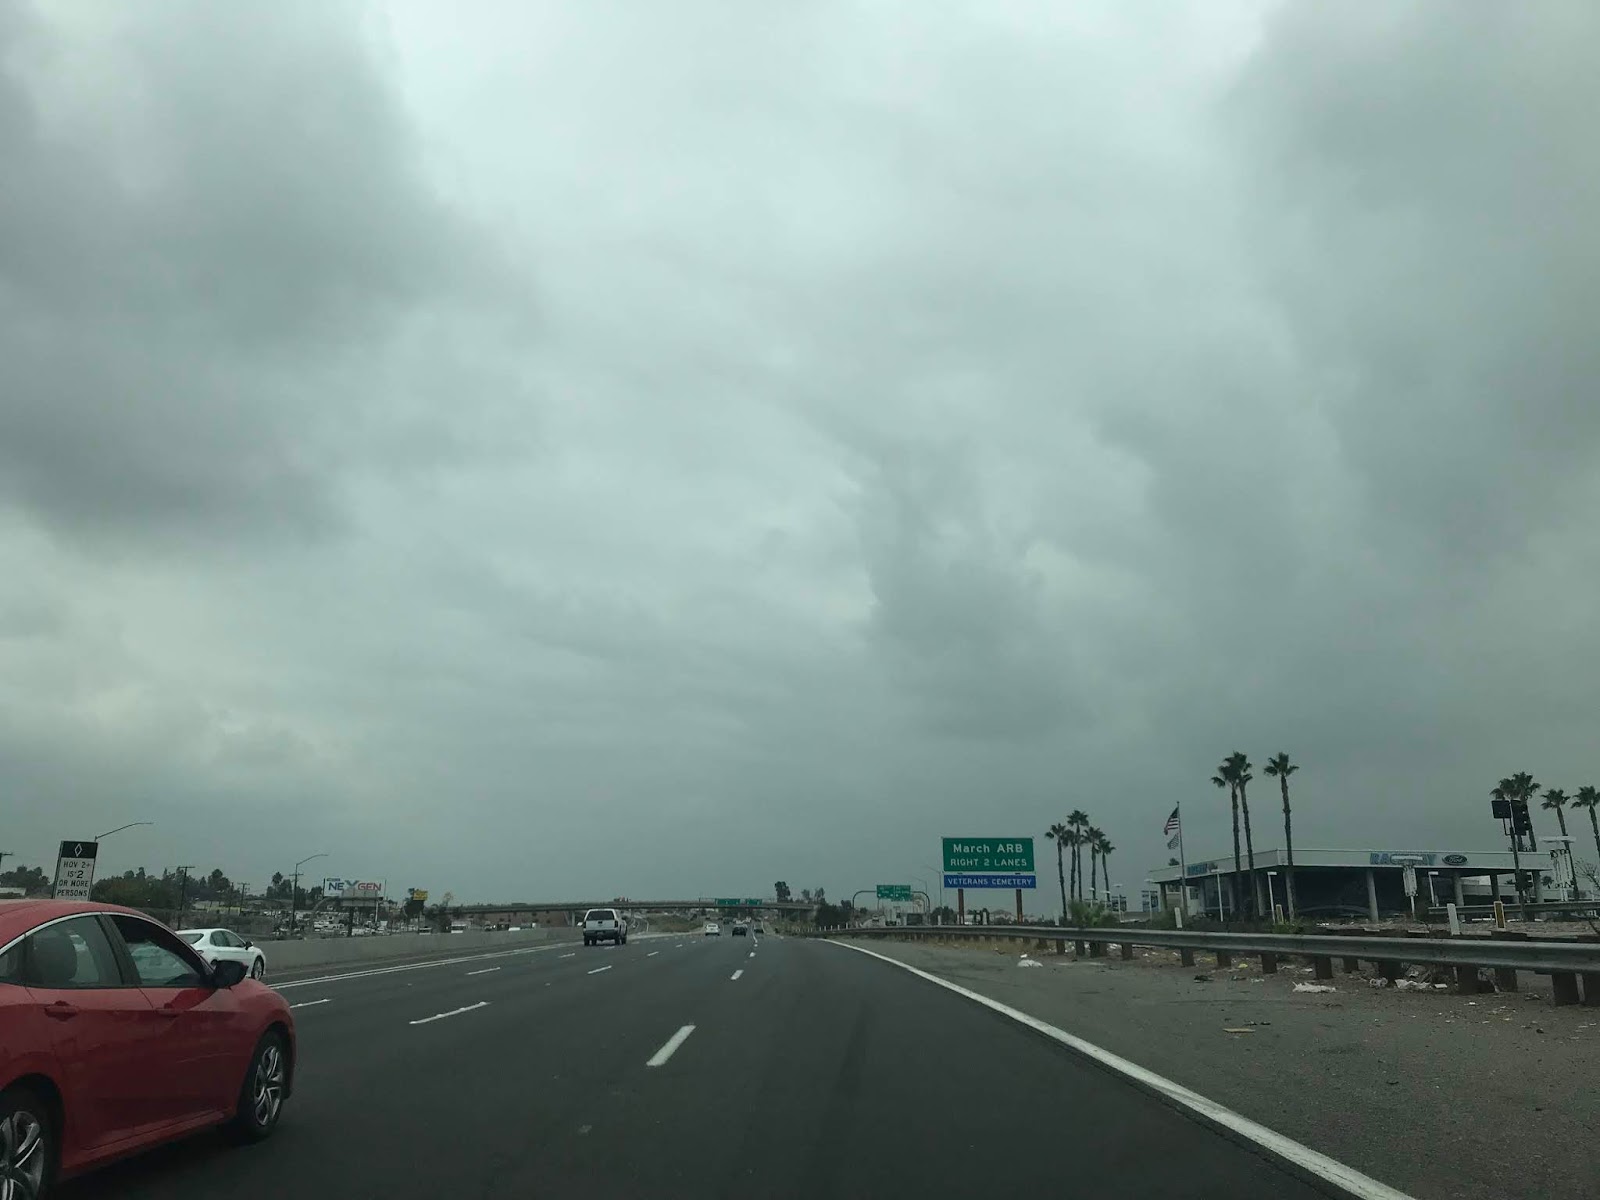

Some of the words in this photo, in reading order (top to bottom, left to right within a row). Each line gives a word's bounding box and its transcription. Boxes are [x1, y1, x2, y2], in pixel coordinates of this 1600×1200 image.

[953, 843, 990, 853] March
[997, 843, 1023, 853] ARB
[950, 858, 978, 866] RIGHT
[984, 858, 990, 866] 2
[994, 858, 1027, 866] LANES
[1370, 852, 1437, 865] RACAY
[1446, 855, 1465, 864] Ford
[67, 870, 74, 878] IS
[76, 870, 84, 879] 2
[56, 889, 88, 897] PERSONS
